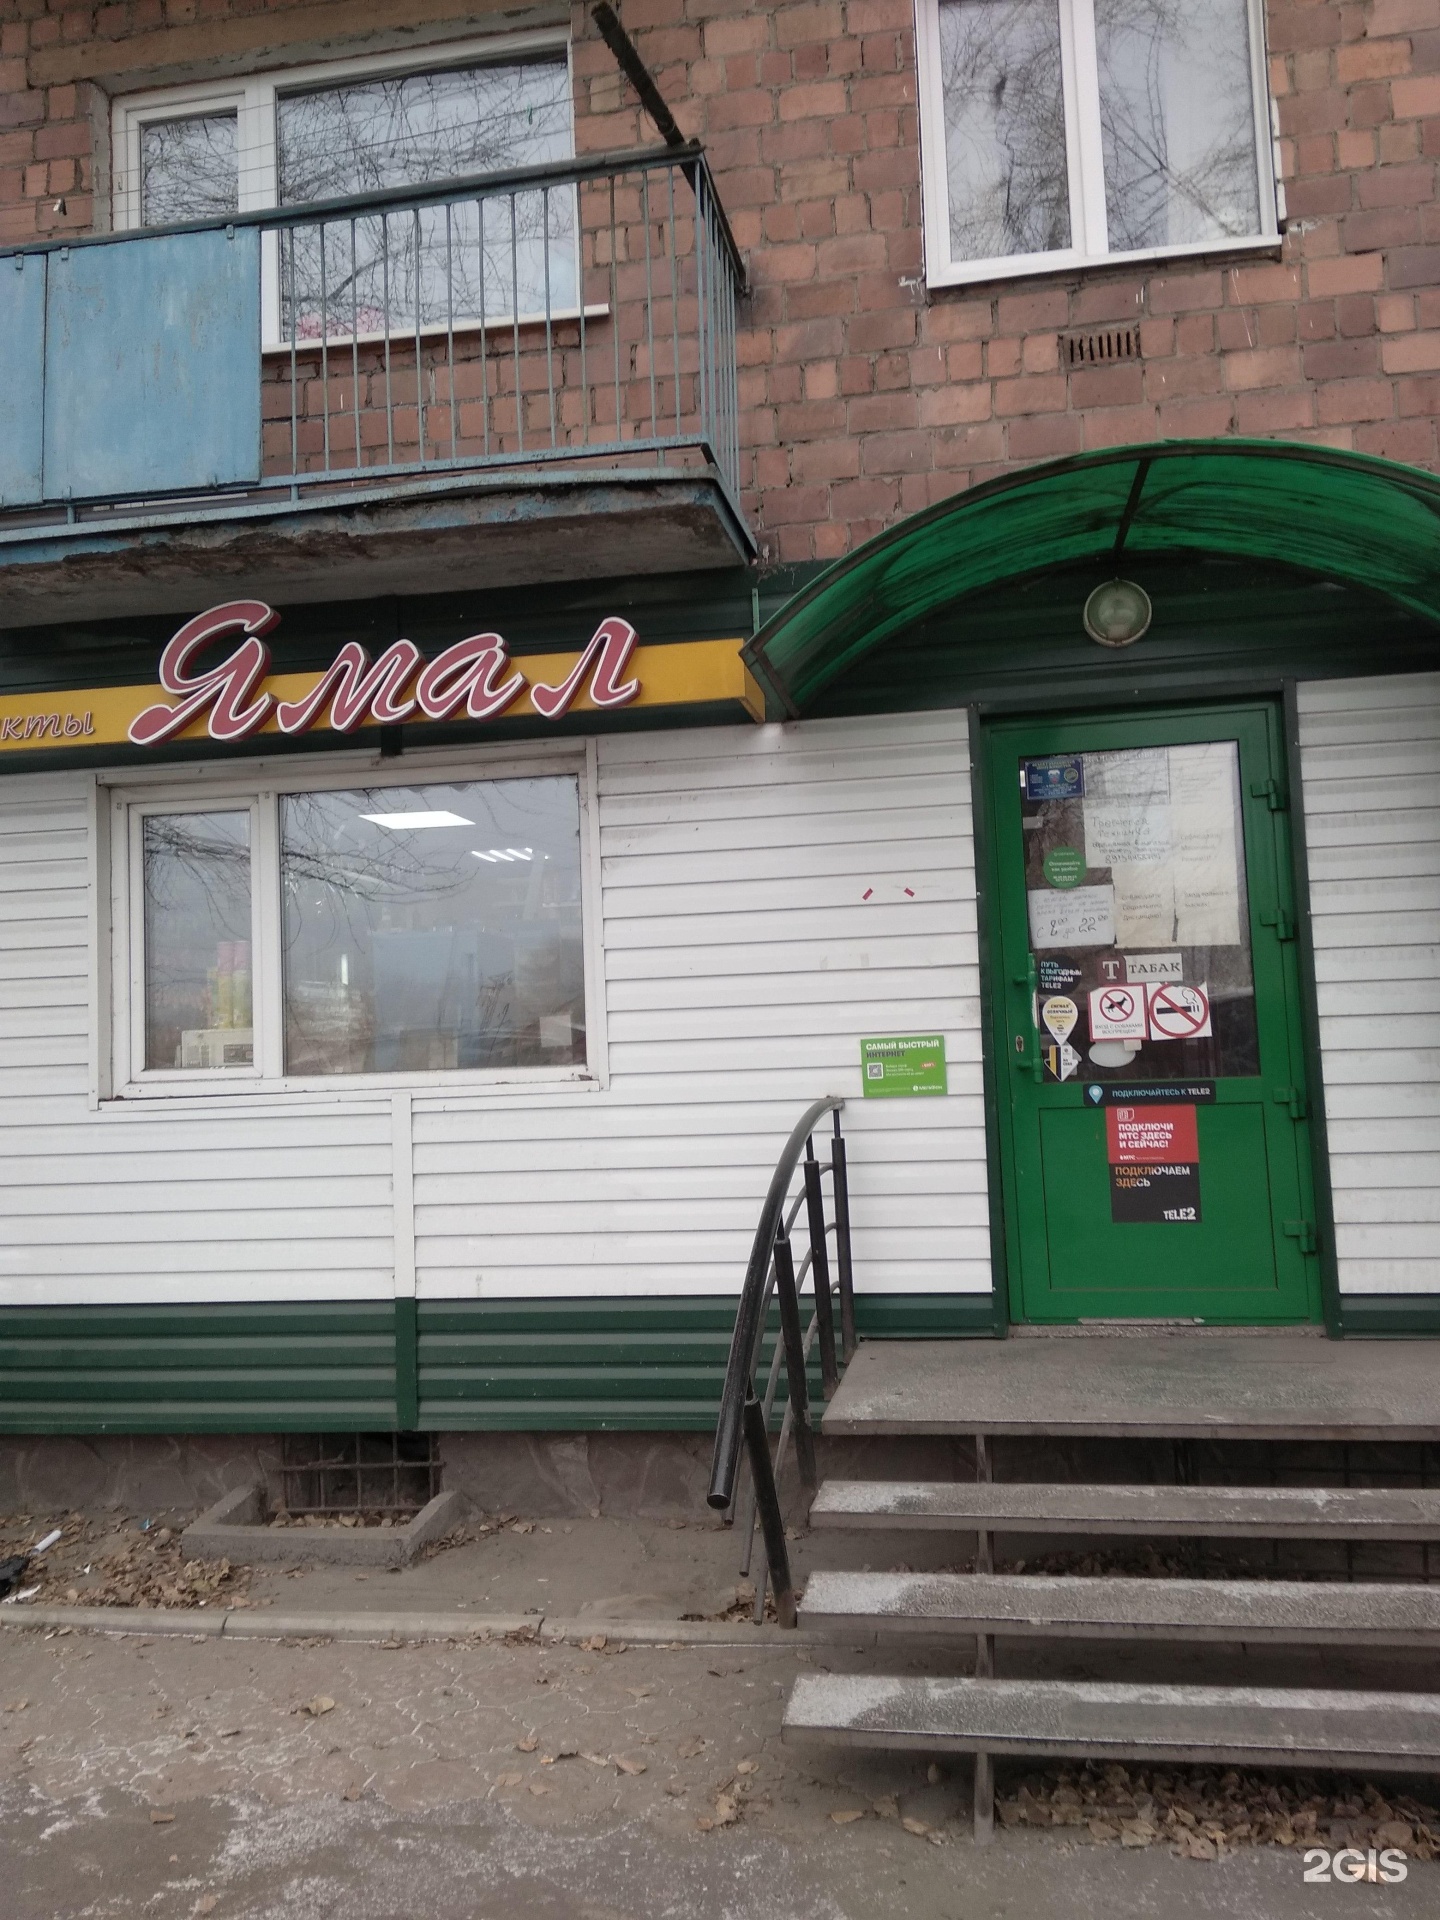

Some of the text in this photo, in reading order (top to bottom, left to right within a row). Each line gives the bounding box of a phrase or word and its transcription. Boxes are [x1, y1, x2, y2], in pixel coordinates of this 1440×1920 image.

[128, 599, 642, 747] Ямал
[1128, 962, 1181, 974] ТАБАК
[865, 1039, 940, 1051] САМЫЙ БЫСТРЫЙ
[866, 1050, 906, 1059] ИНТЕРНЕТ
[1112, 1088, 1180, 1098] ПОДКЛЮЧАЙТЕСЬ
[1187, 1087, 1211, 1096] TELE2
[1118, 1122, 1174, 1132] ПОДКЛЮЧИ
[1118, 1131, 1172, 1141] МТС ЗДЕСЬ
[1119, 1139, 1169, 1149] И СЕЙЧАС!
[1115, 1166, 1191, 1177] ПОДКЛЮЧАЕМ
[1115, 1177, 1151, 1188] ЗДЕСЬ
[1163, 1206, 1197, 1221] TELE2
